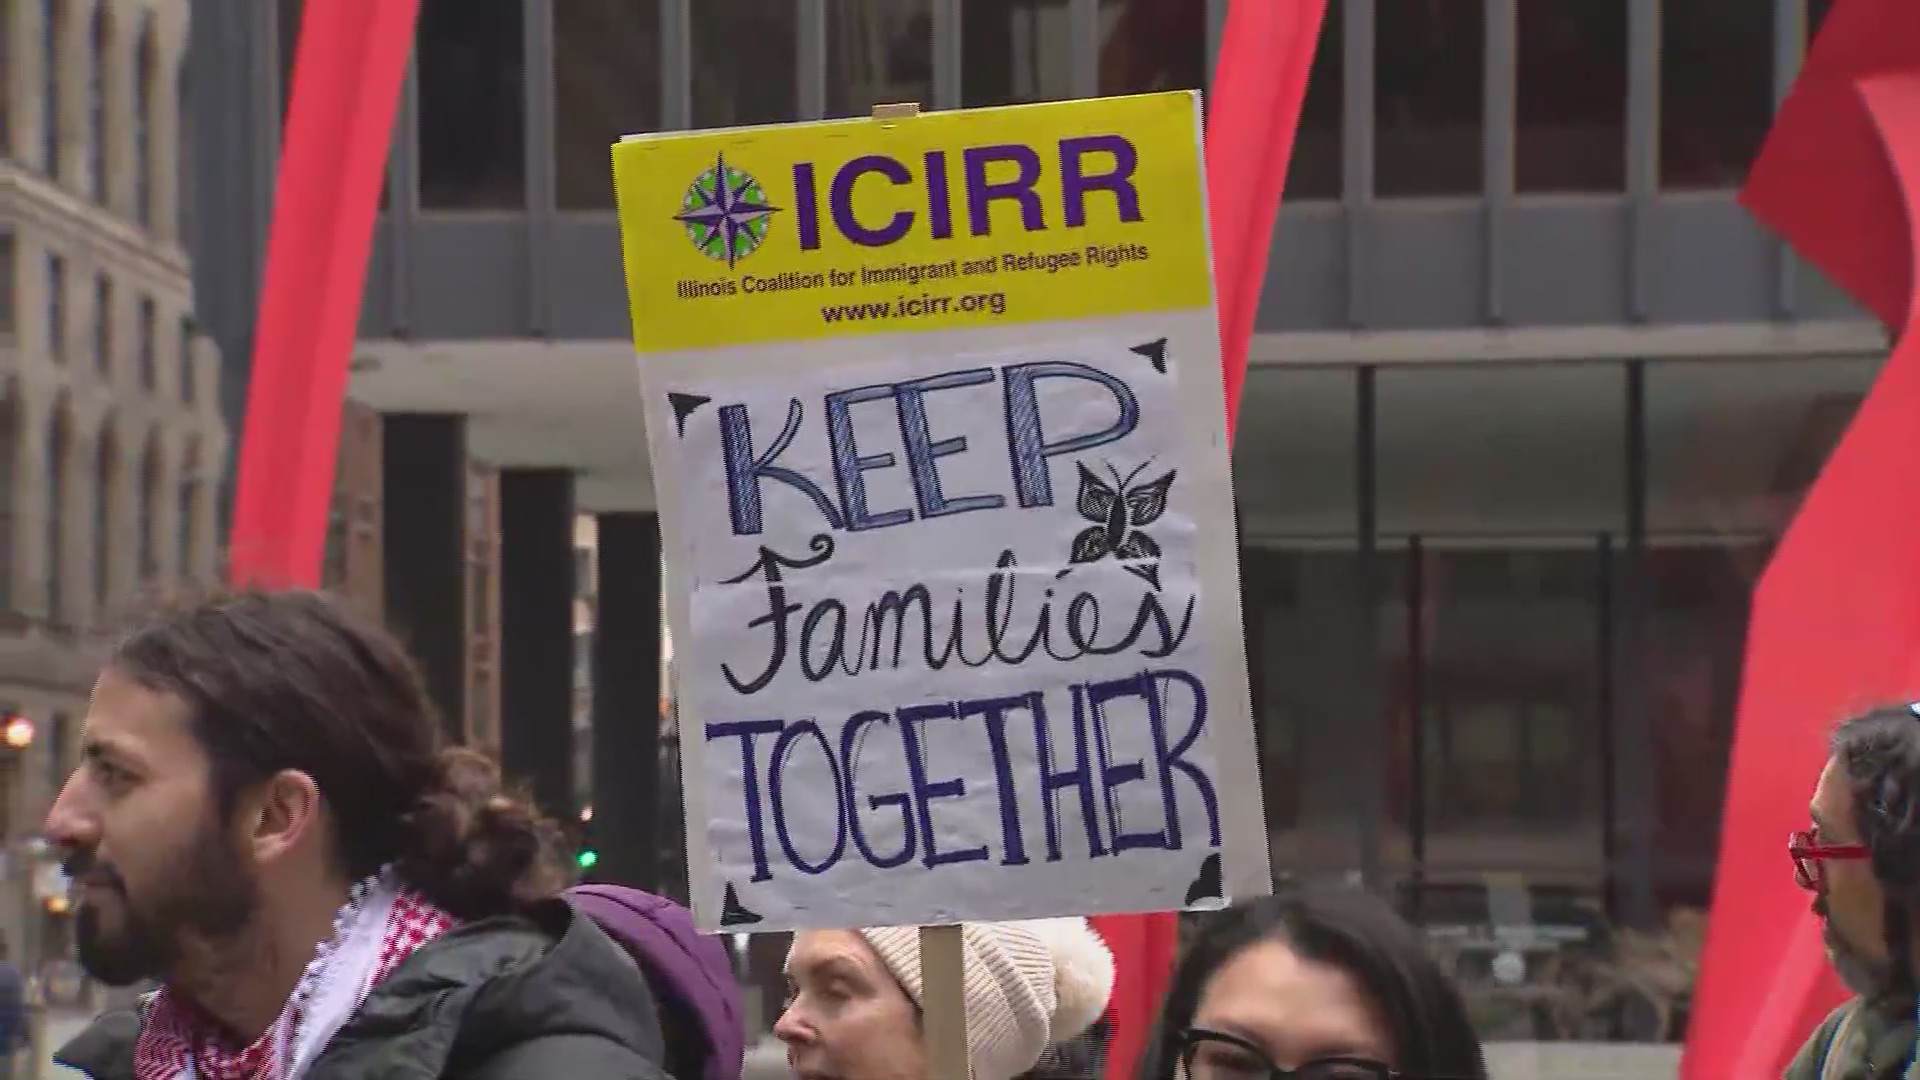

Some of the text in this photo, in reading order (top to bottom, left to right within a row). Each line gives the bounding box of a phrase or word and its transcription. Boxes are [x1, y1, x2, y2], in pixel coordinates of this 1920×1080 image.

[792, 134, 1144, 252] ICIRR
[676, 243, 1149, 300] Illinois Coalition for Immigrant and Refugee Rights
[821, 290, 1006, 325] www.icirr.org
[717, 360, 1140, 536] KEEP
[718, 533, 1196, 694] Families
[706, 669, 1221, 882] TOGETHER
